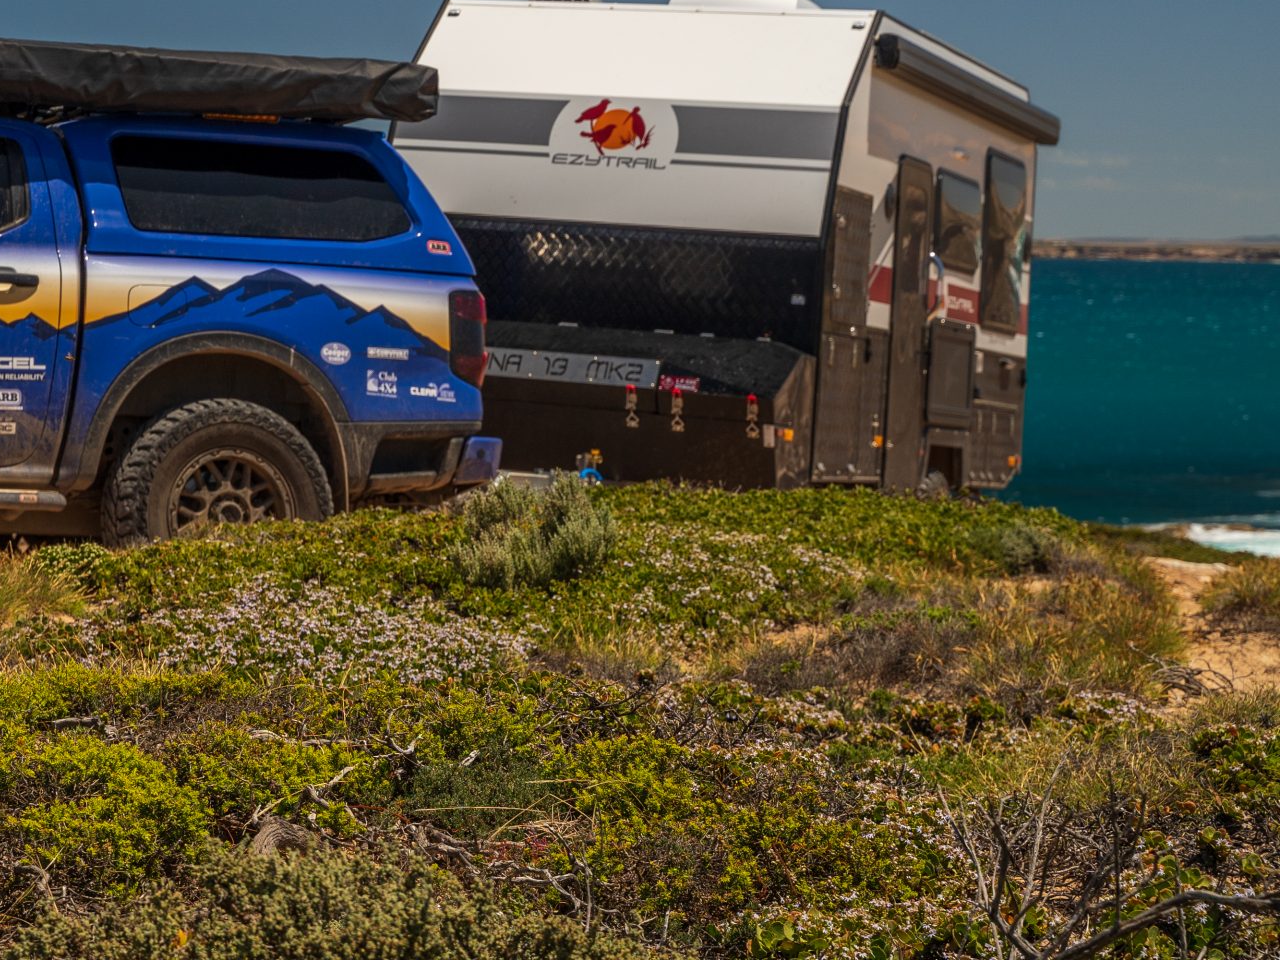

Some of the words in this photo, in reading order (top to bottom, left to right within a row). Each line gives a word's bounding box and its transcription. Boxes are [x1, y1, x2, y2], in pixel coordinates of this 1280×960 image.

[551, 153, 666, 170] EZYTRAIL
[378, 372, 397, 381] Club
[585, 360, 644, 382] MK2
[5, 373, 45, 381] RELIABILITY
[379, 383, 397, 394] 4X4
